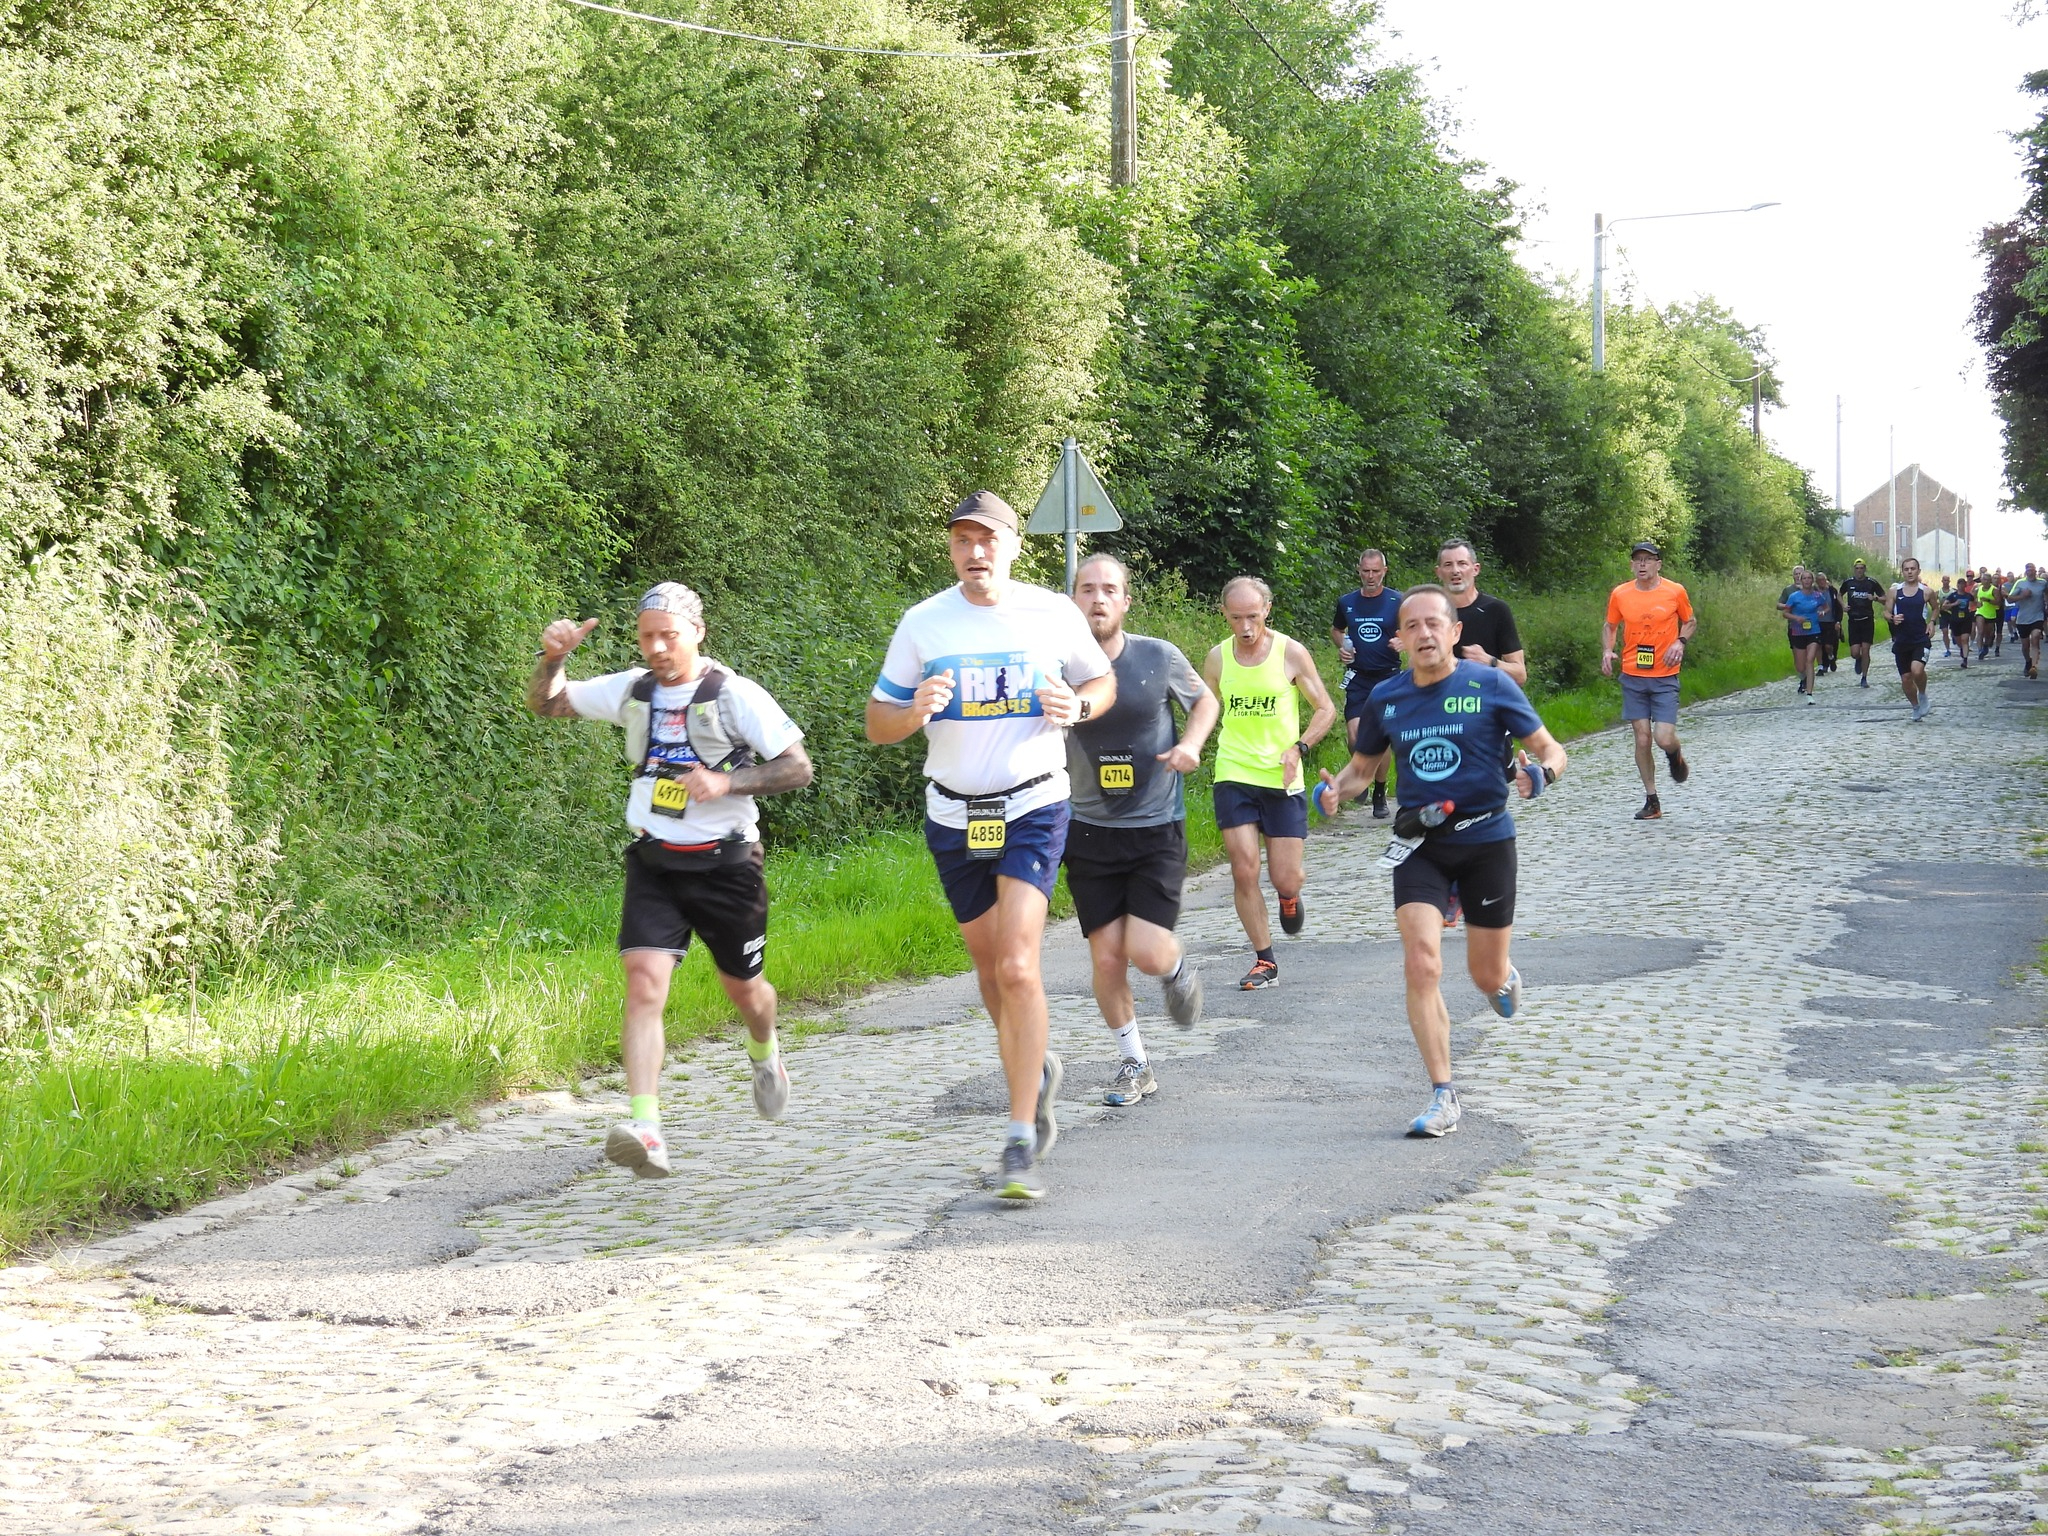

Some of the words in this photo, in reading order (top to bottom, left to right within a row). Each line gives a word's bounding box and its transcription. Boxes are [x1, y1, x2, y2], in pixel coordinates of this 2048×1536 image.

[960, 666, 1035, 702] RUN
[1234, 696, 1269, 710] RUN
[1444, 696, 1482, 714] GIGI
[1400, 728, 1421, 742] TEAM
[1414, 746, 1454, 764] cora
[1104, 769, 1131, 782] 4714
[971, 826, 1003, 842] 4858
